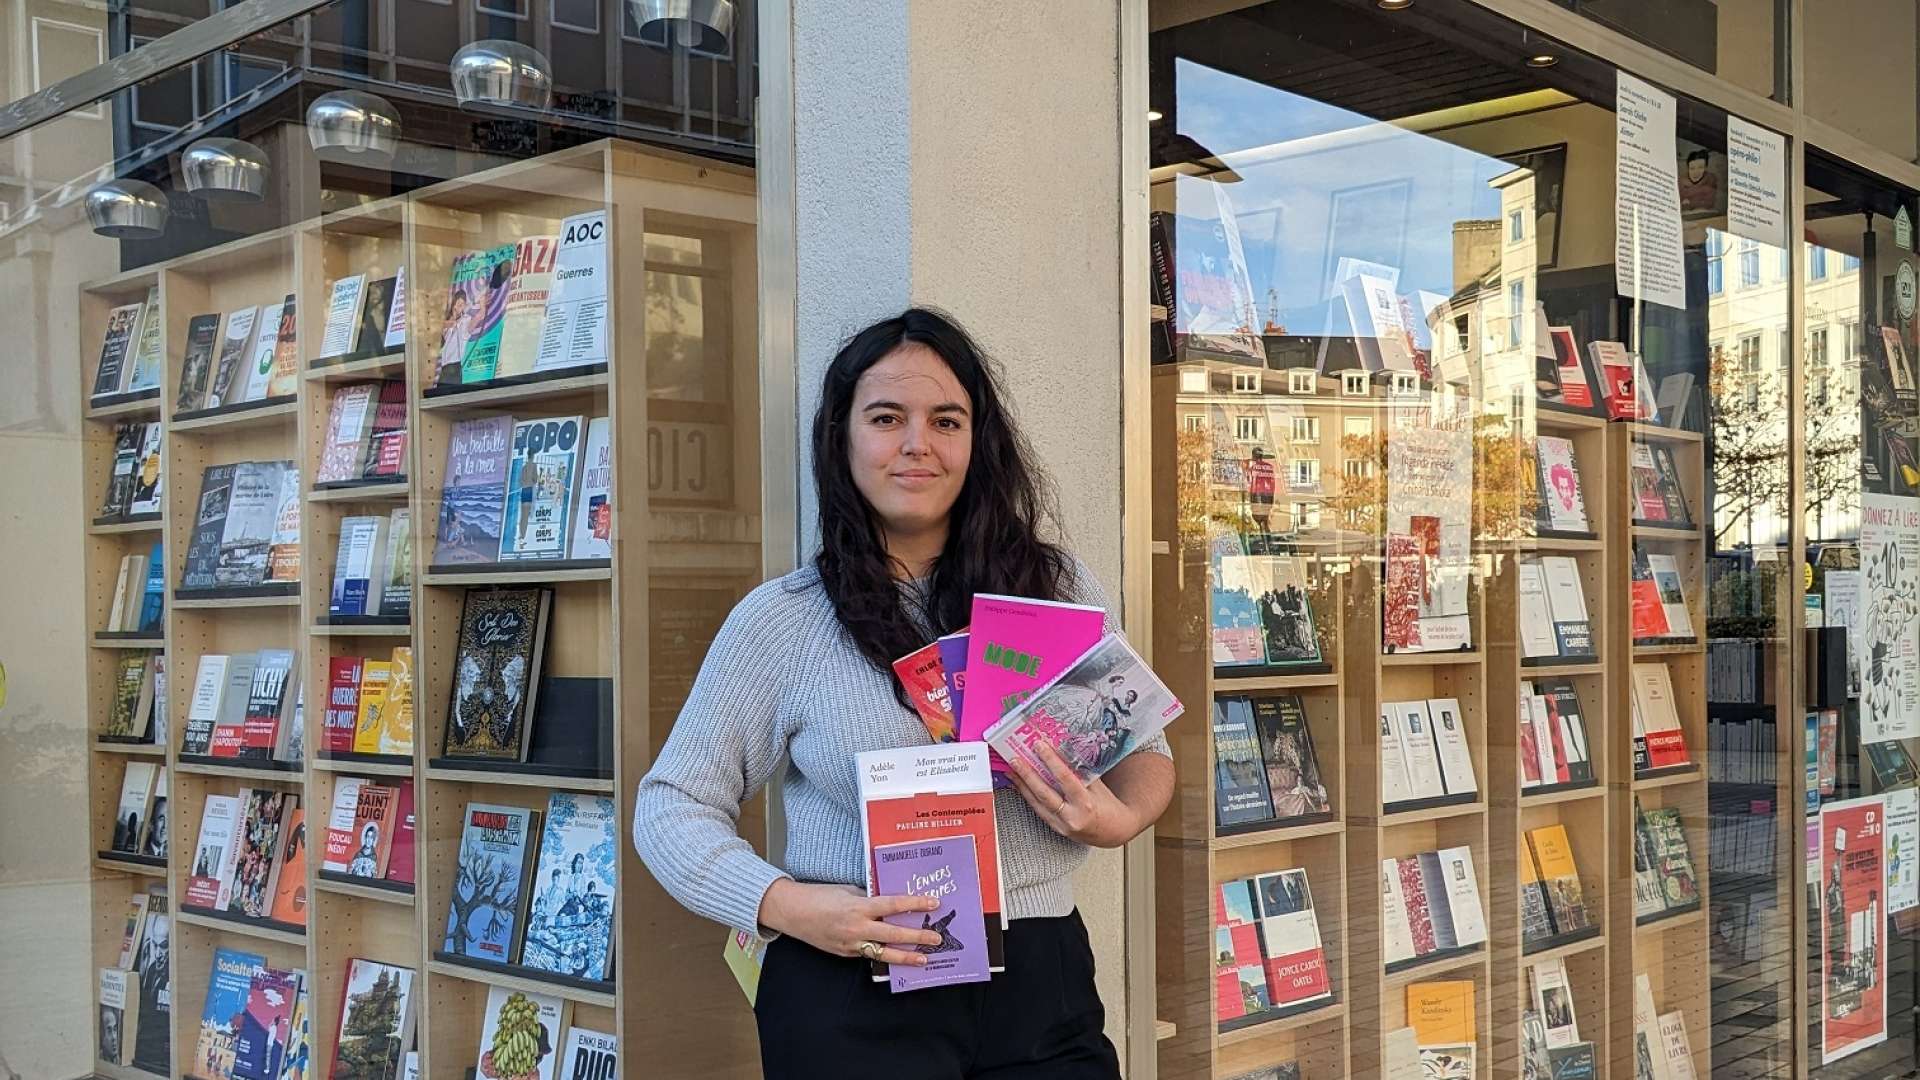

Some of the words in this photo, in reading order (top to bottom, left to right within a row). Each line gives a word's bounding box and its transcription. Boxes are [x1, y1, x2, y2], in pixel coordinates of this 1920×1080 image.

[564, 221, 603, 245] AOC
[556, 267, 593, 281] Guerres
[515, 421, 578, 458] TOPO
[1863, 506, 1893, 526] DONNEZ
[1881, 541, 1897, 588] 10
[1559, 624, 1590, 636] EMMANUEL
[983, 641, 1044, 679] MODE
[915, 758, 935, 767] Mon
[938, 755, 956, 765] vrai
[957, 753, 976, 763] nom
[869, 762, 895, 773] Adèle
[916, 768, 927, 778] est
[871, 773, 888, 783] Yon
[357, 793, 388, 808] SAINT
[356, 806, 385, 820] LUIGI
[916, 810, 931, 818] Les
[932, 807, 985, 818] Contemplées
[896, 821, 928, 831] PAULINE
[930, 819, 963, 829] HILLIER
[329, 832, 353, 844] FOUCAU
[882, 849, 918, 863] EMMANUELLE
[920, 845, 942, 858] DURAND
[907, 864, 952, 896] L'ENVERS
[218, 957, 252, 977] Socialte
[1278, 964, 1300, 980] JOYCE
[1292, 975, 1313, 988] OATES
[579, 1034, 597, 1047] ENKI
[597, 1038, 617, 1052] BILA
